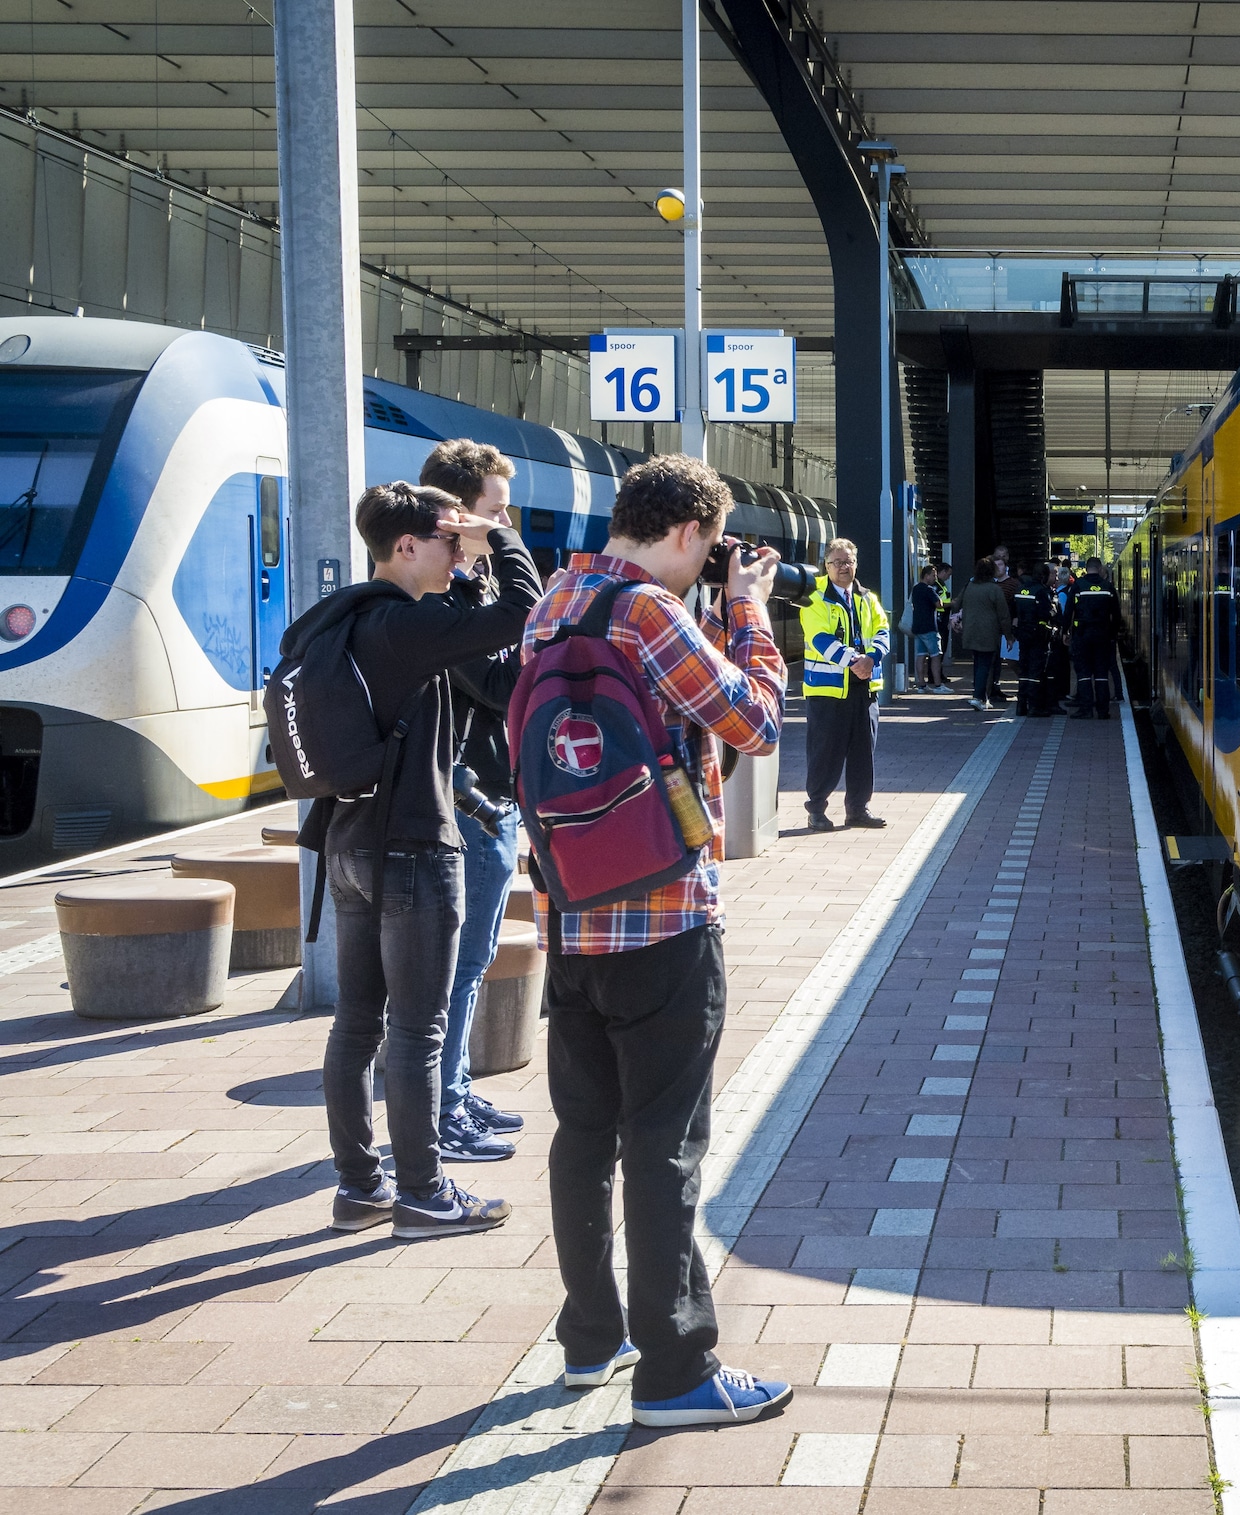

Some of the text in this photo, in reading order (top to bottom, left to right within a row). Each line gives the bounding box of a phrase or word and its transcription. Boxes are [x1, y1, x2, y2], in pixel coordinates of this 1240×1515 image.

[609, 342, 636, 351] spoor
[727, 343, 754, 352] spoor
[604, 367, 660, 412] 16
[321, 584, 336, 592] 201
[283, 691, 315, 779] Reebok
